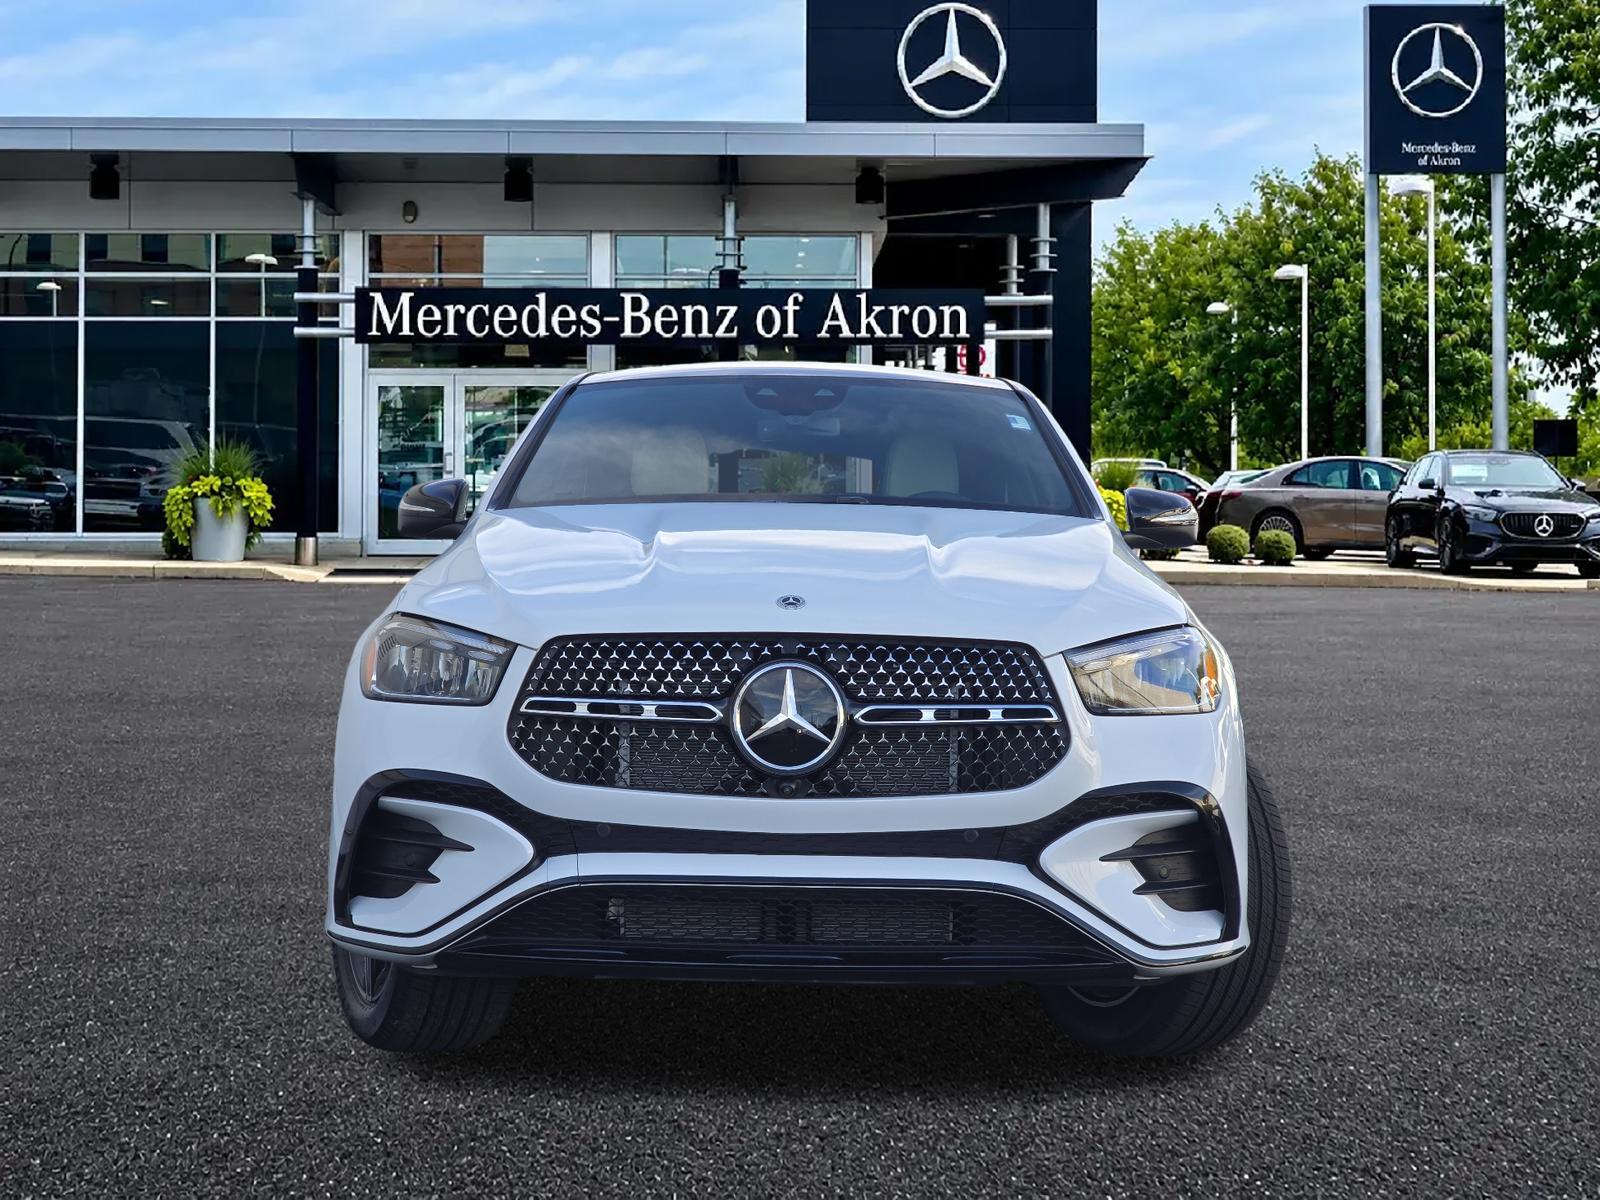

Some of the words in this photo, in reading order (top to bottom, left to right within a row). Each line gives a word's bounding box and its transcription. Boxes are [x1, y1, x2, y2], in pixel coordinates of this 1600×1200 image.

[1401, 142, 1477, 154] Mercedes-Benz
[1417, 154, 1428, 166] of
[1429, 154, 1461, 166] Akron
[367, 291, 738, 338] Mercedes-Benz
[754, 291, 801, 338] of
[816, 292, 970, 338] Akron
